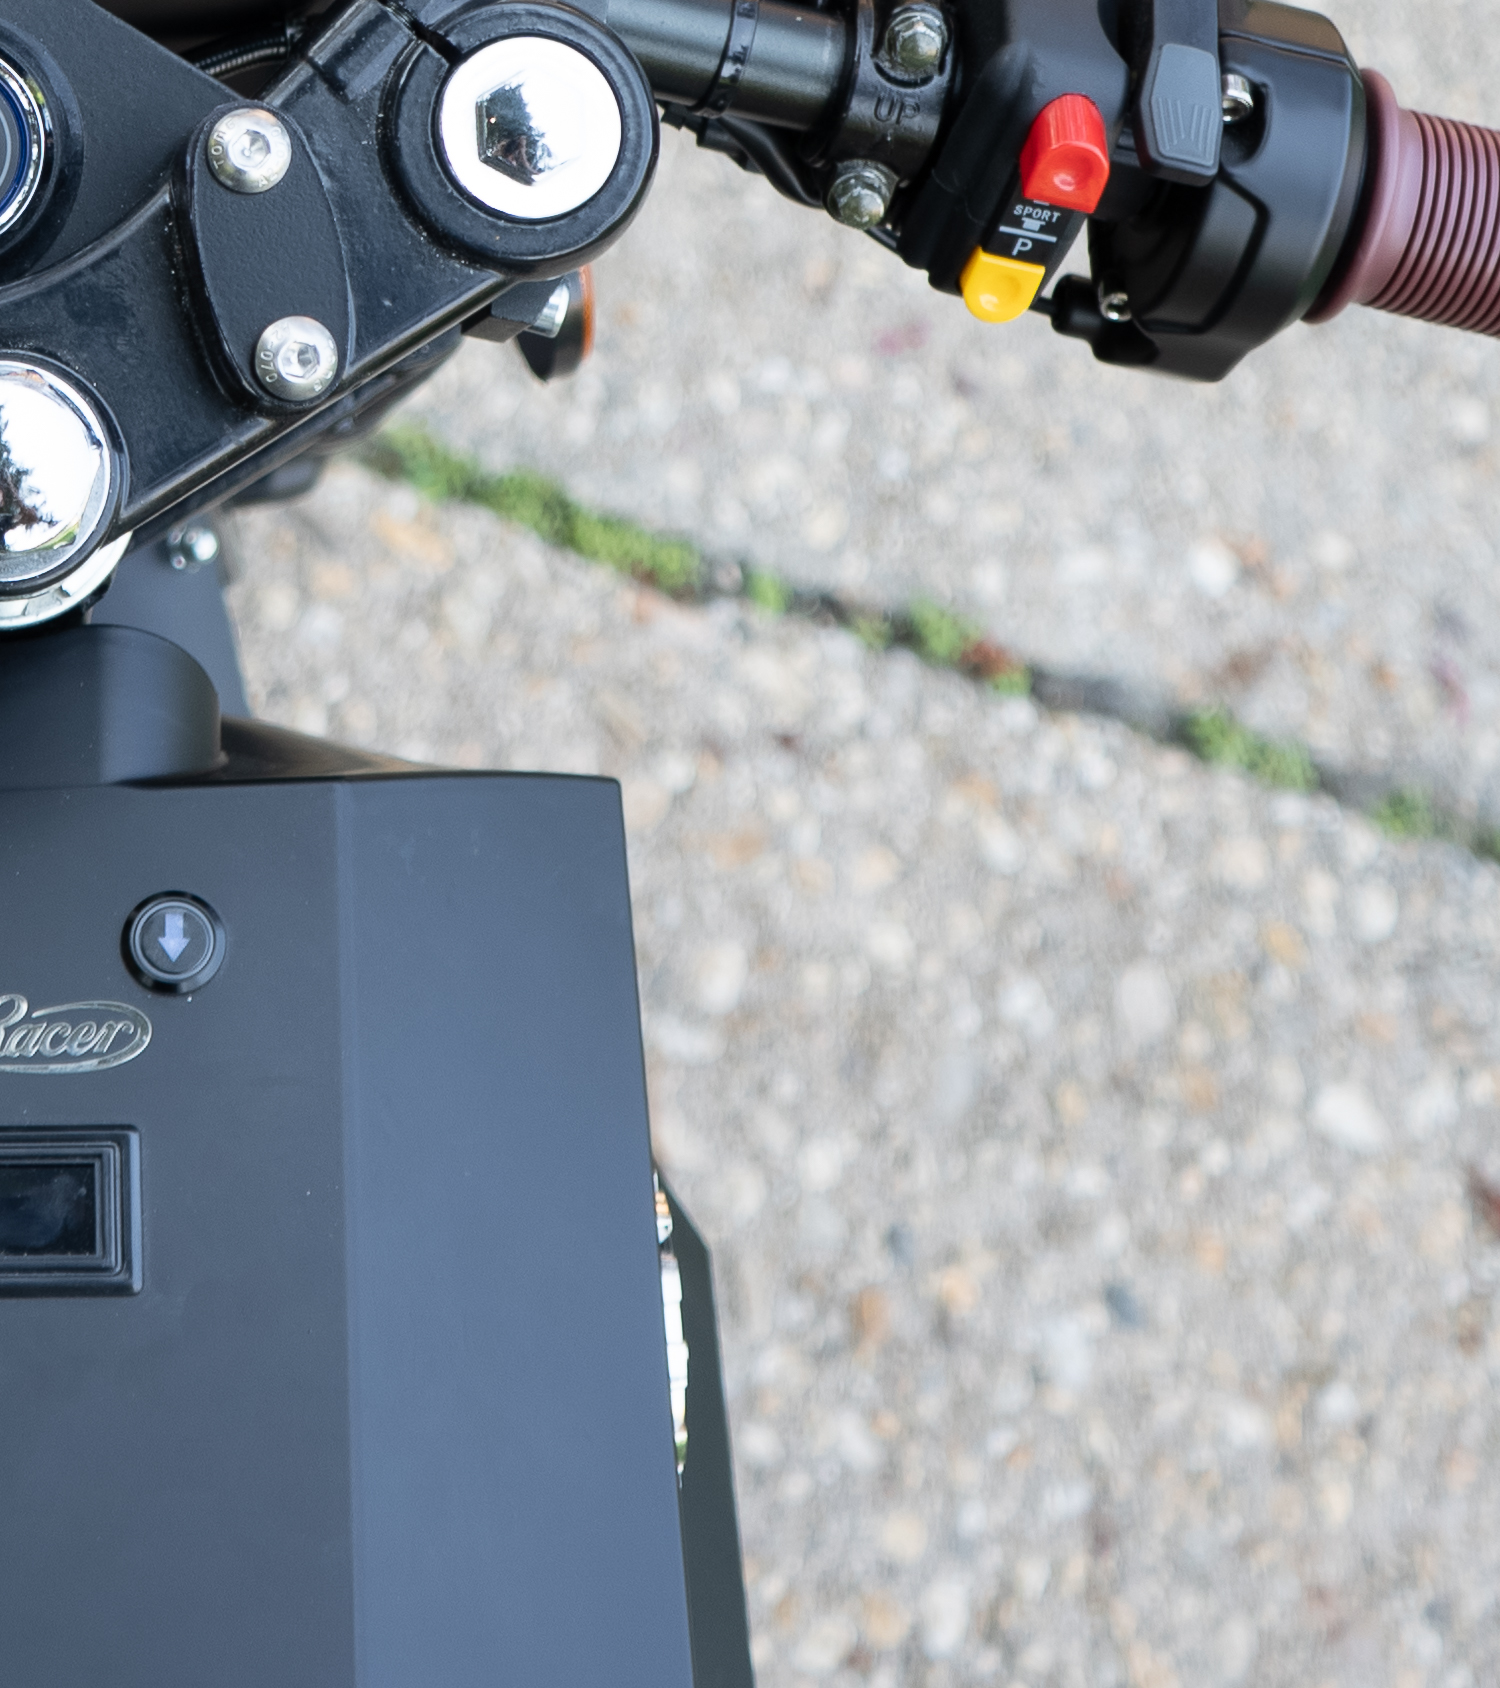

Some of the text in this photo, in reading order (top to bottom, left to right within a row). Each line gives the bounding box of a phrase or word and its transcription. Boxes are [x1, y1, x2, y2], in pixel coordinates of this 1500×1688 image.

[874, 95, 920, 125] UP
[1013, 204, 1061, 223] SPORT
[1012, 238, 1033, 256] P
